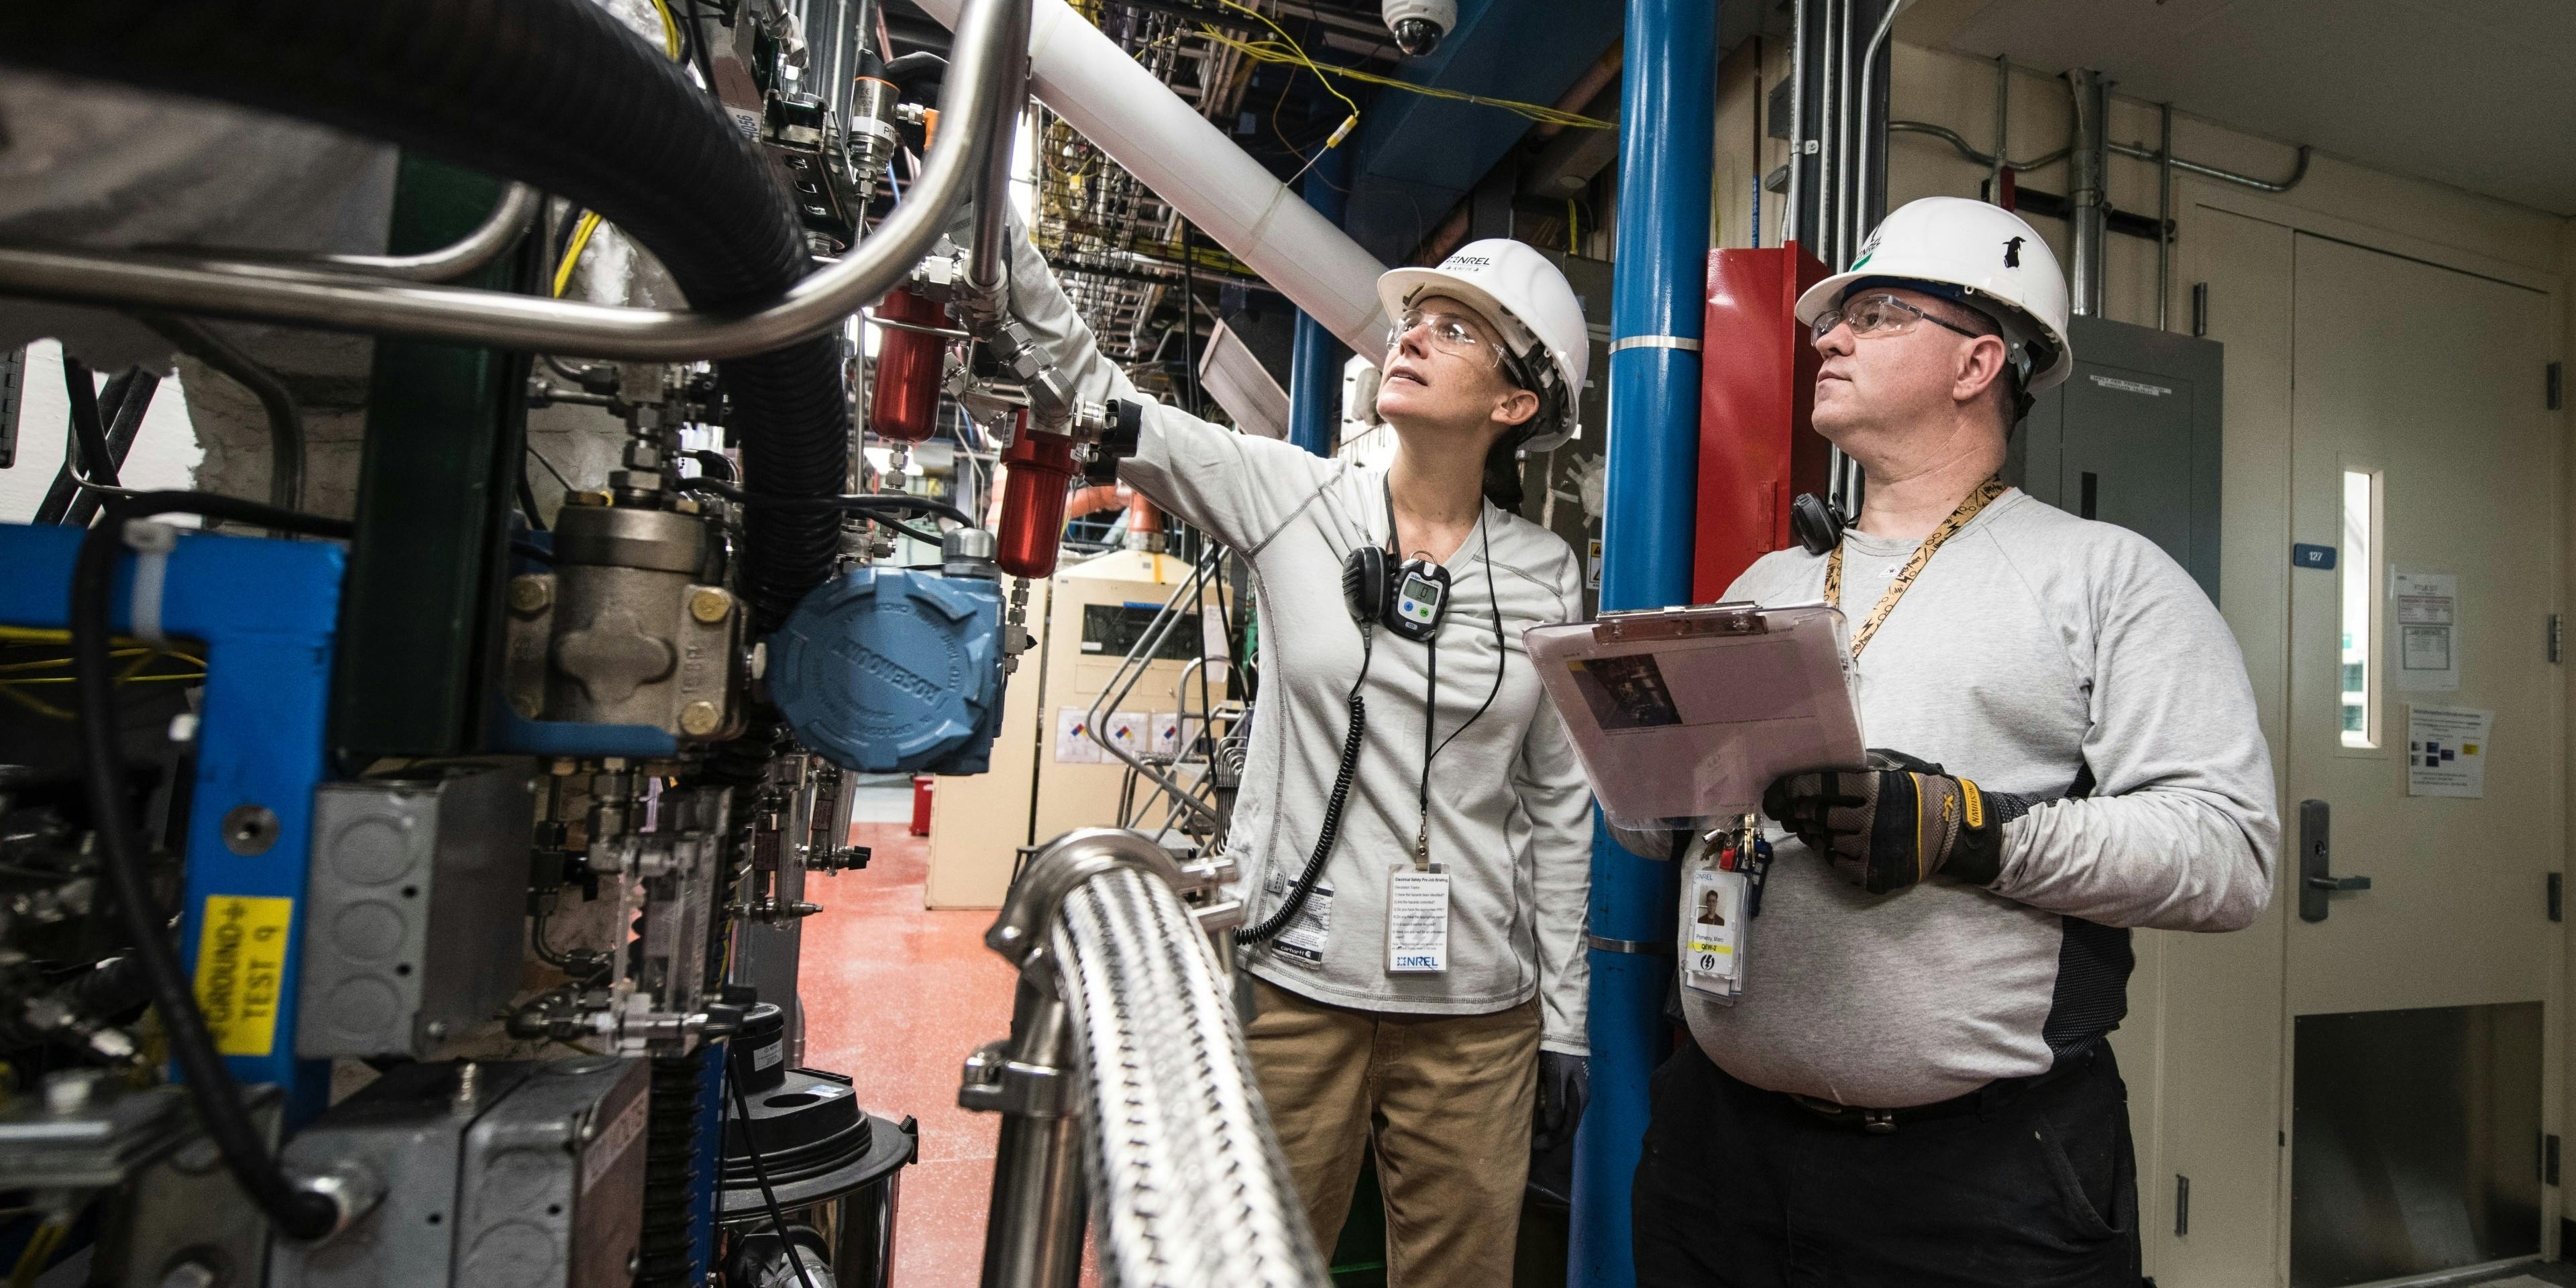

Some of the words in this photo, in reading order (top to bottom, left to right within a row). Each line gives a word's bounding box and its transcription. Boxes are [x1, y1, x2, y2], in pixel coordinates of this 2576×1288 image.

[1457, 256, 1490, 266] NREL
[2309, 551, 2323, 561] 127
[1281, 945, 1305, 957] carhartt
[1701, 943, 1717, 951] QEW-2
[1407, 957, 1438, 966] NREL
[241, 959, 277, 1020] TEST
